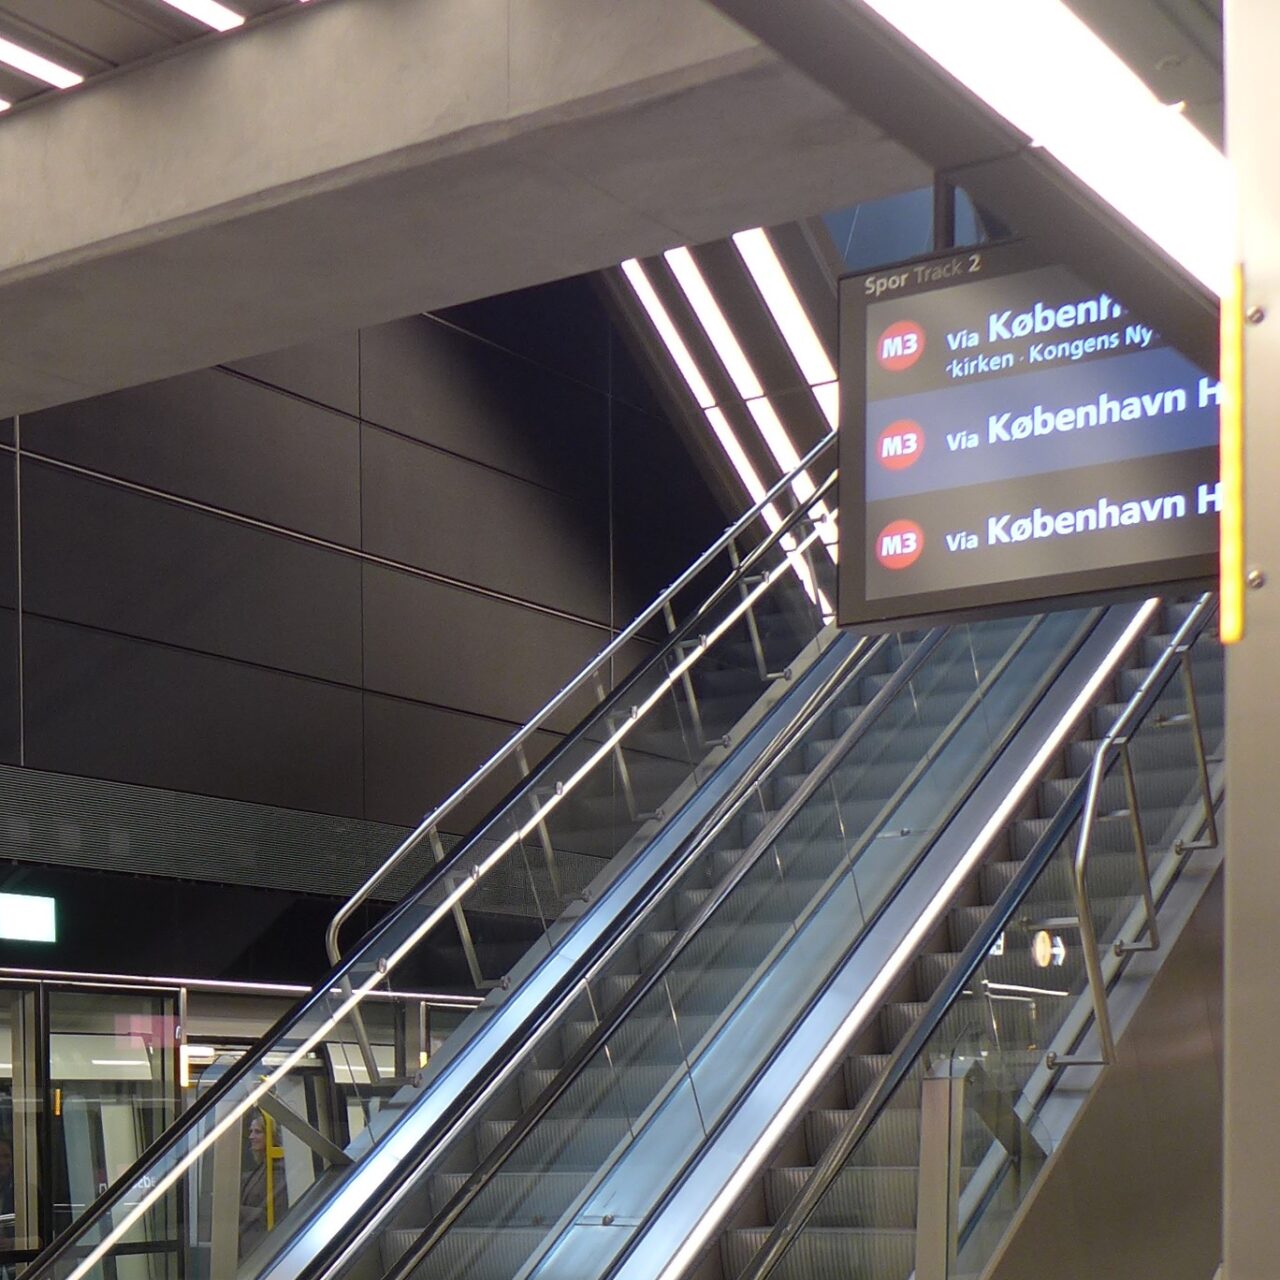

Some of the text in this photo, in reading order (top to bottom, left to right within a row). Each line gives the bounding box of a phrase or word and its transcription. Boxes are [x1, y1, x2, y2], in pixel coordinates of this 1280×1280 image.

[864, 254, 982, 296] Spor Track 2
[947, 293, 1122, 351] Via Københ
[881, 333, 918, 359] M3
[1028, 331, 1120, 364] Kongens
[1124, 323, 1154, 348] Ny
[946, 377, 1222, 451] Via København H
[881, 432, 918, 459] M3
[946, 482, 1223, 552] Via København H
[880, 532, 917, 557] M3
